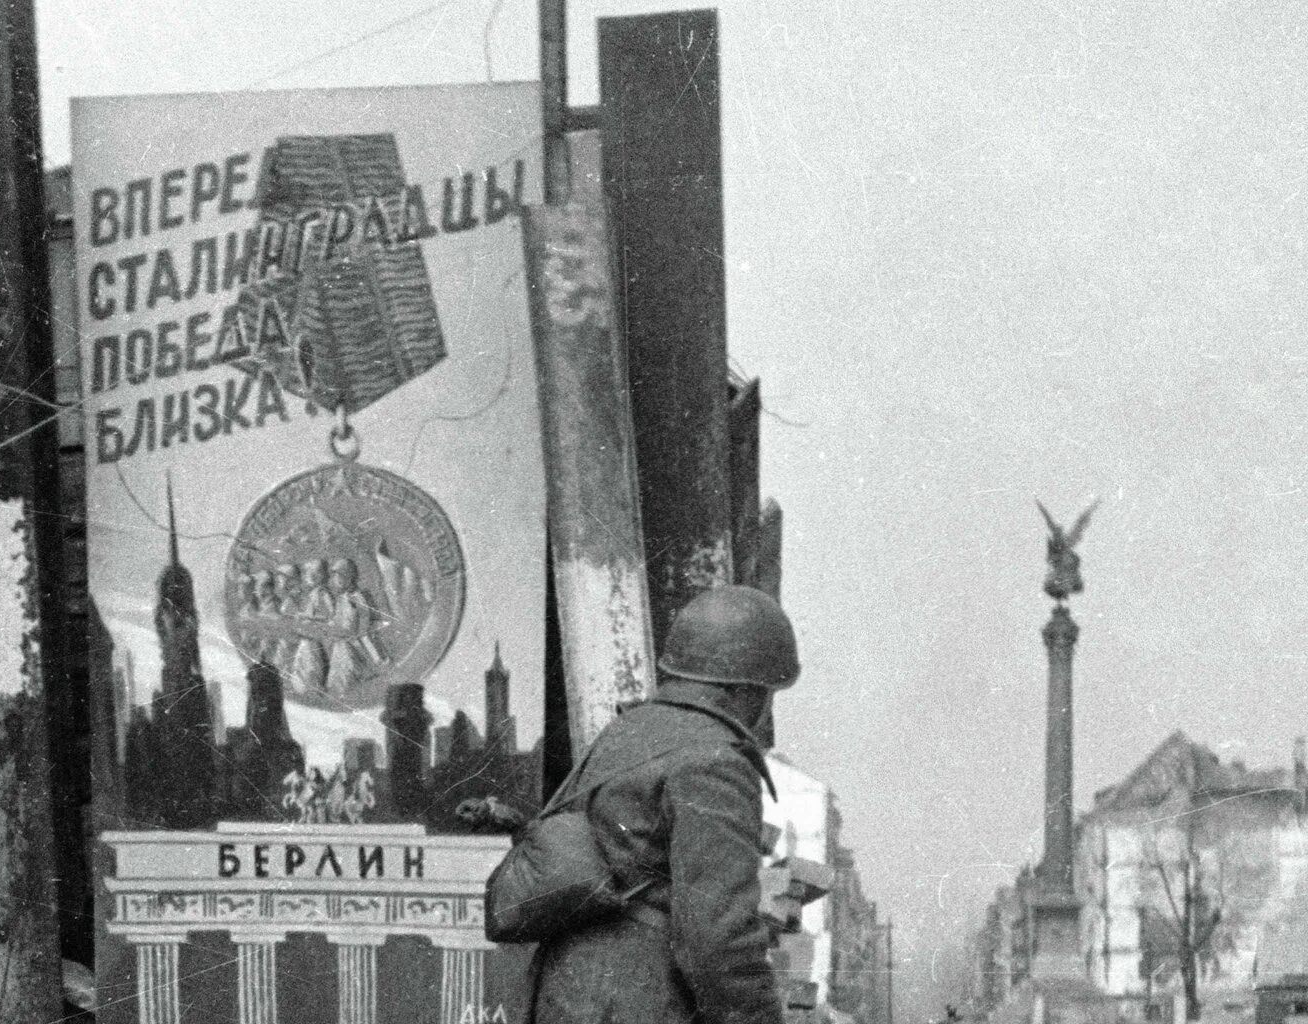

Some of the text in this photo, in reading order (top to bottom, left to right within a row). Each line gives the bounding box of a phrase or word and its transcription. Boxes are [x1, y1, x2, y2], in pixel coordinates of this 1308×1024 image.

[88, 159, 525, 321] СТАЛИНГРАДЦЫ
[94, 299, 290, 394] ПОБЕДА
[218, 843, 426, 879] БЕРЛИН
